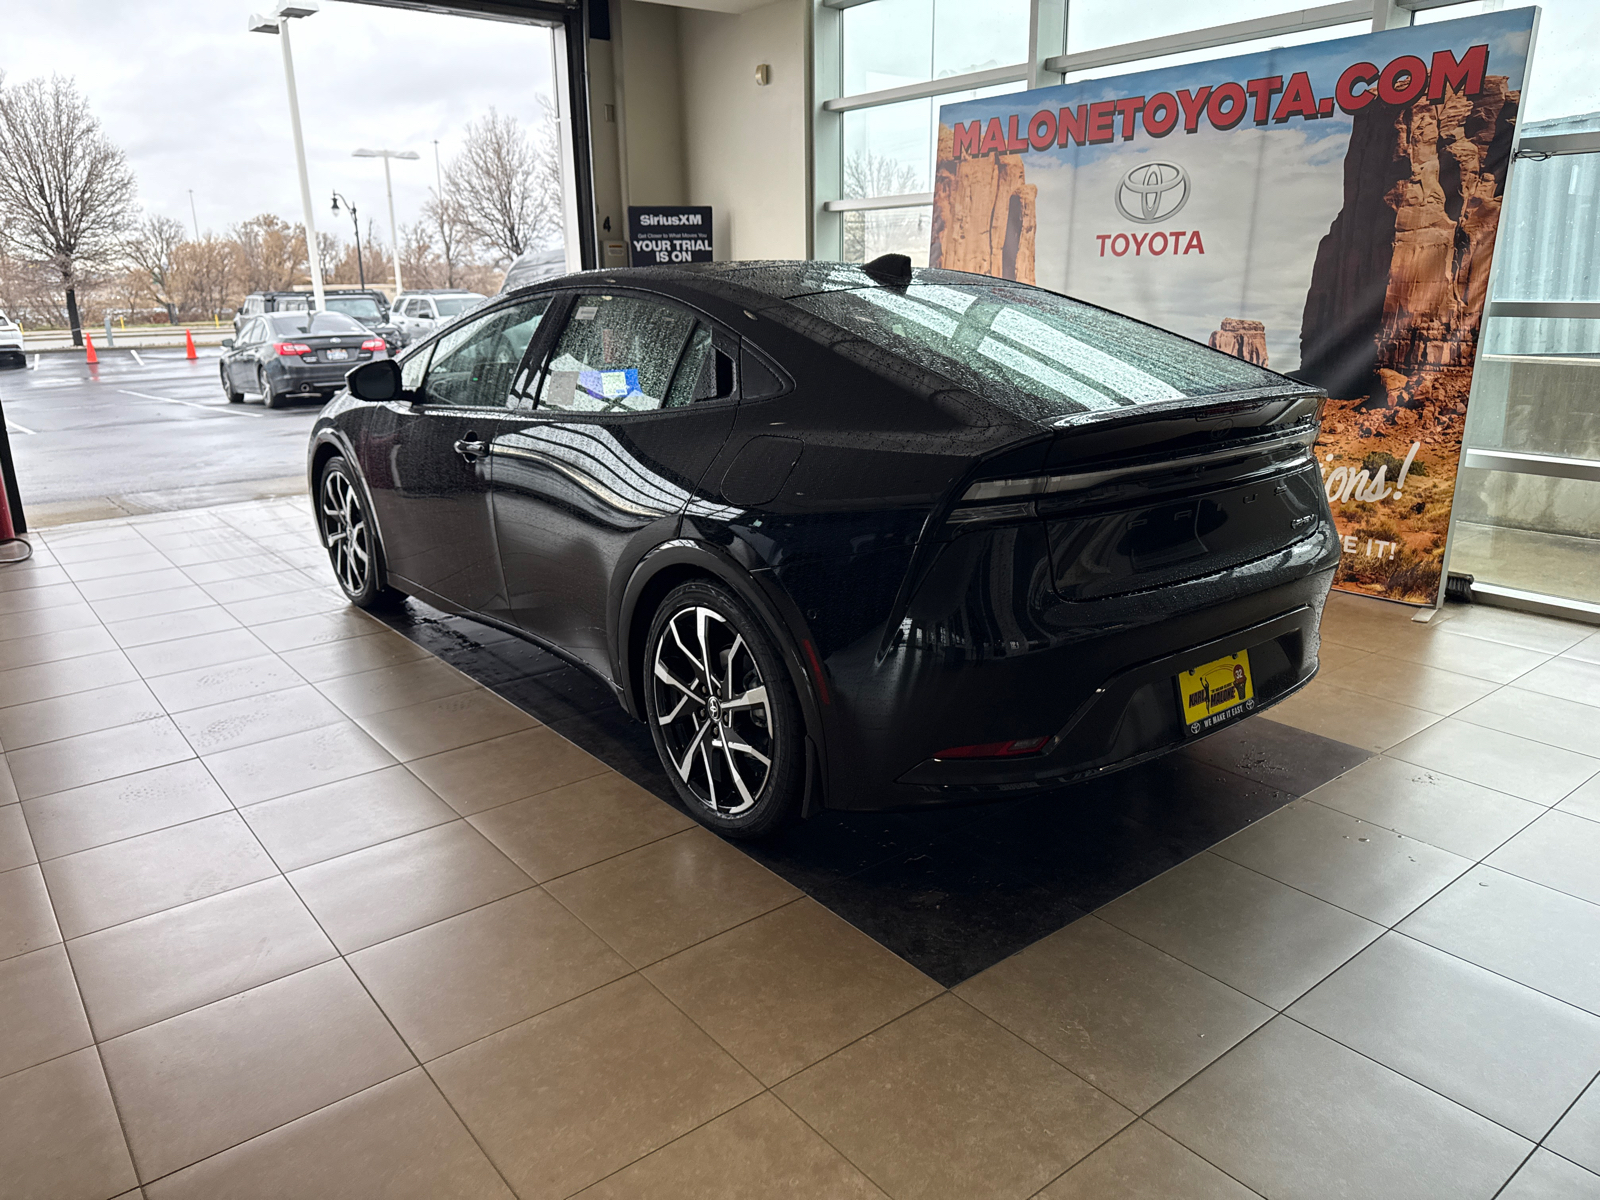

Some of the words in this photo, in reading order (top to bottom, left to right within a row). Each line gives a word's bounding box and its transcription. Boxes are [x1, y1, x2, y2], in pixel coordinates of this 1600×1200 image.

[952, 44, 1490, 160] MALONETOYOTA.COM
[603, 216, 611, 233] 4
[640, 214, 702, 226] SiriusXM
[633, 240, 670, 252] YOUR
[673, 239, 712, 251] TRIAL
[1096, 230, 1205, 257] TOYOTA
[655, 252, 669, 263] IS
[671, 251, 692, 262] ON
[1338, 534, 1358, 554] E
[1366, 538, 1396, 560] IT!
[1235, 669, 1243, 679] 32
[1204, 718, 1212, 727] WE
[1212, 713, 1226, 724] MAKE
[1226, 711, 1232, 719] IT
[1232, 704, 1243, 716] EASY
